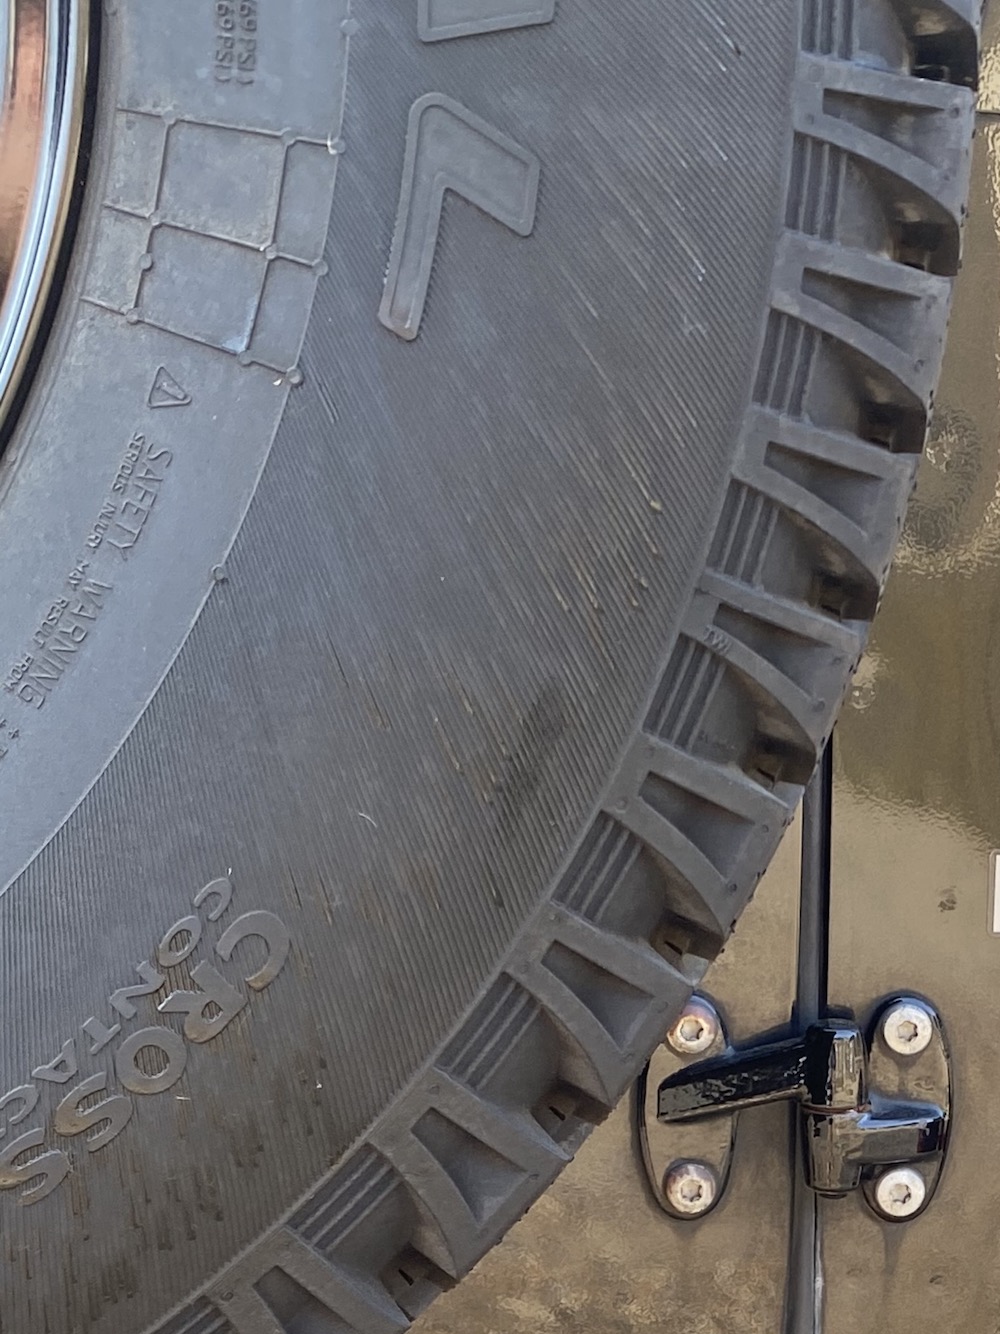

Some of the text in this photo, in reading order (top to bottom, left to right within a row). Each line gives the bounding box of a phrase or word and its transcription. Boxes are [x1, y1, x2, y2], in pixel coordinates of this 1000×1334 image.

[18, 443, 174, 710] SAFETY WARNING
[111, 431, 146, 496] SERIOUS
[32, 596, 70, 649] RESULT
[0, 876, 234, 1139] CONTAC
[0, 910, 290, 1206] CROSS
